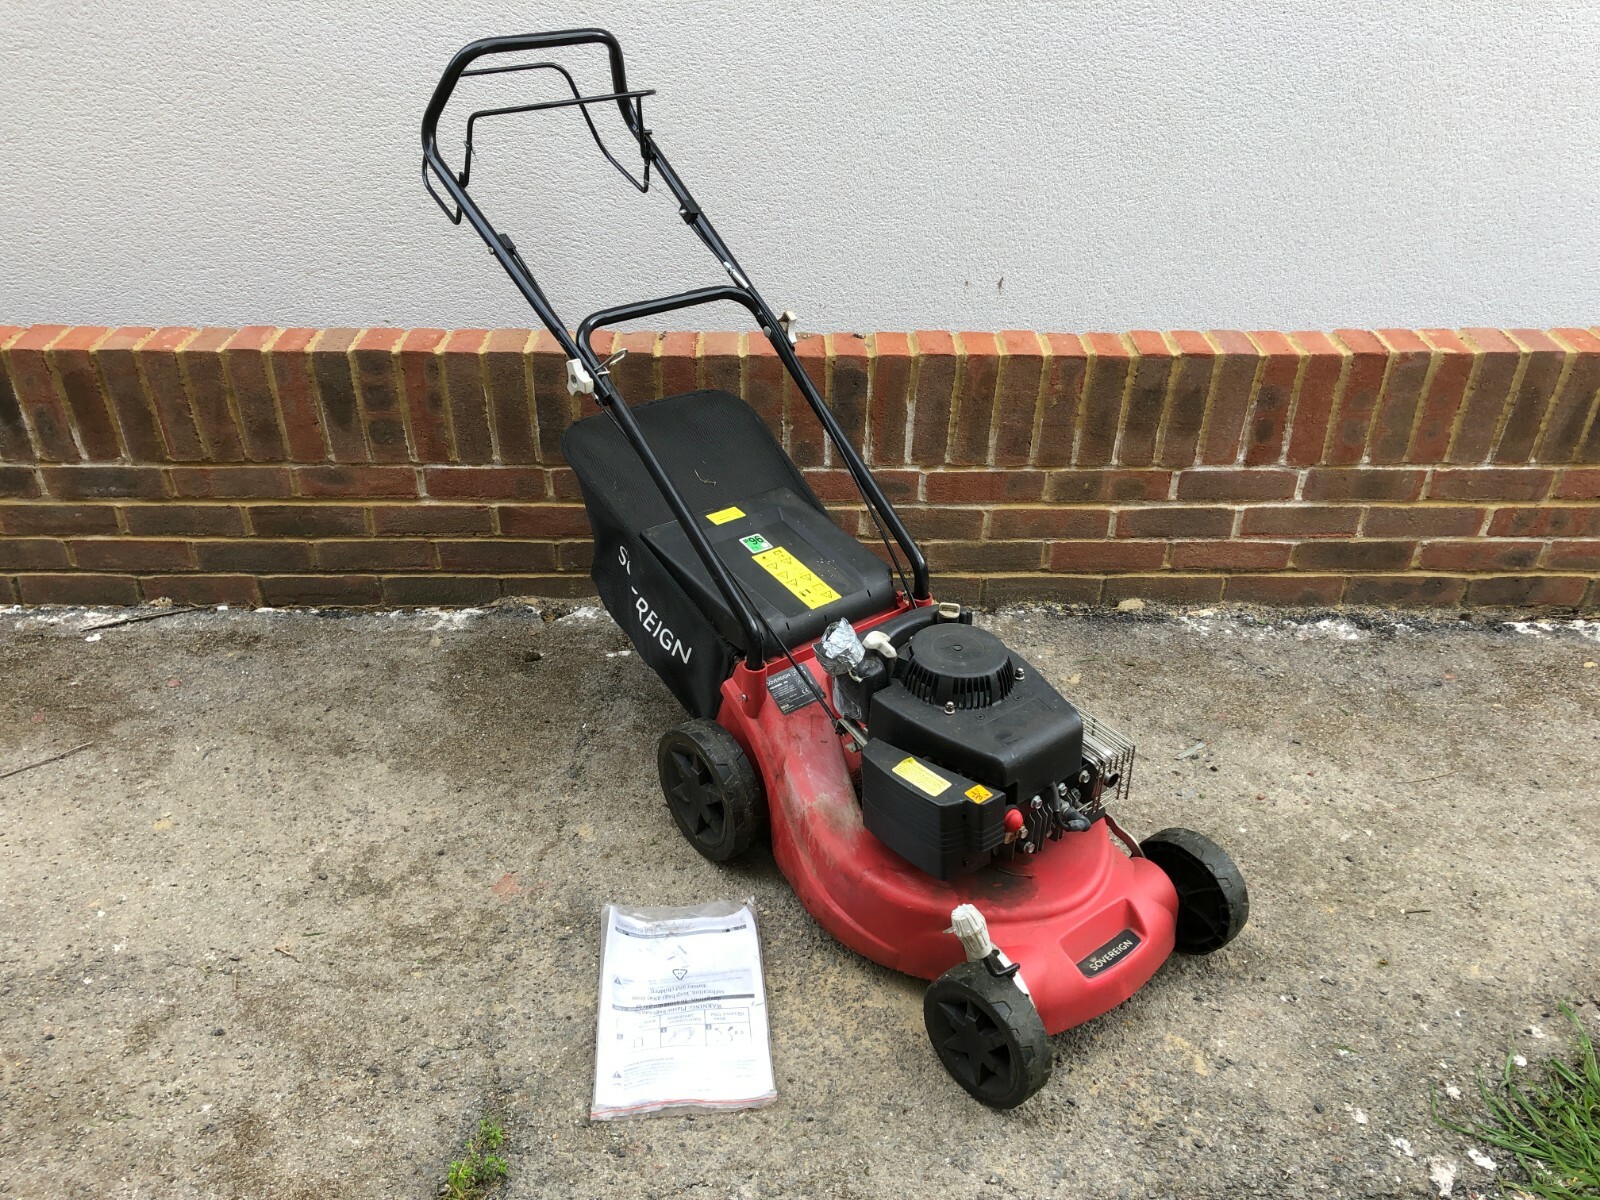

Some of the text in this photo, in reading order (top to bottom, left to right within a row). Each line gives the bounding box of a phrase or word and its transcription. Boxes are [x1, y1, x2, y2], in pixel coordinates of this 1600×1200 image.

[748, 535, 764, 545] 96
[618, 545, 693, 665] SREIGN
[1089, 939, 1133, 971] SOVEREIGN
